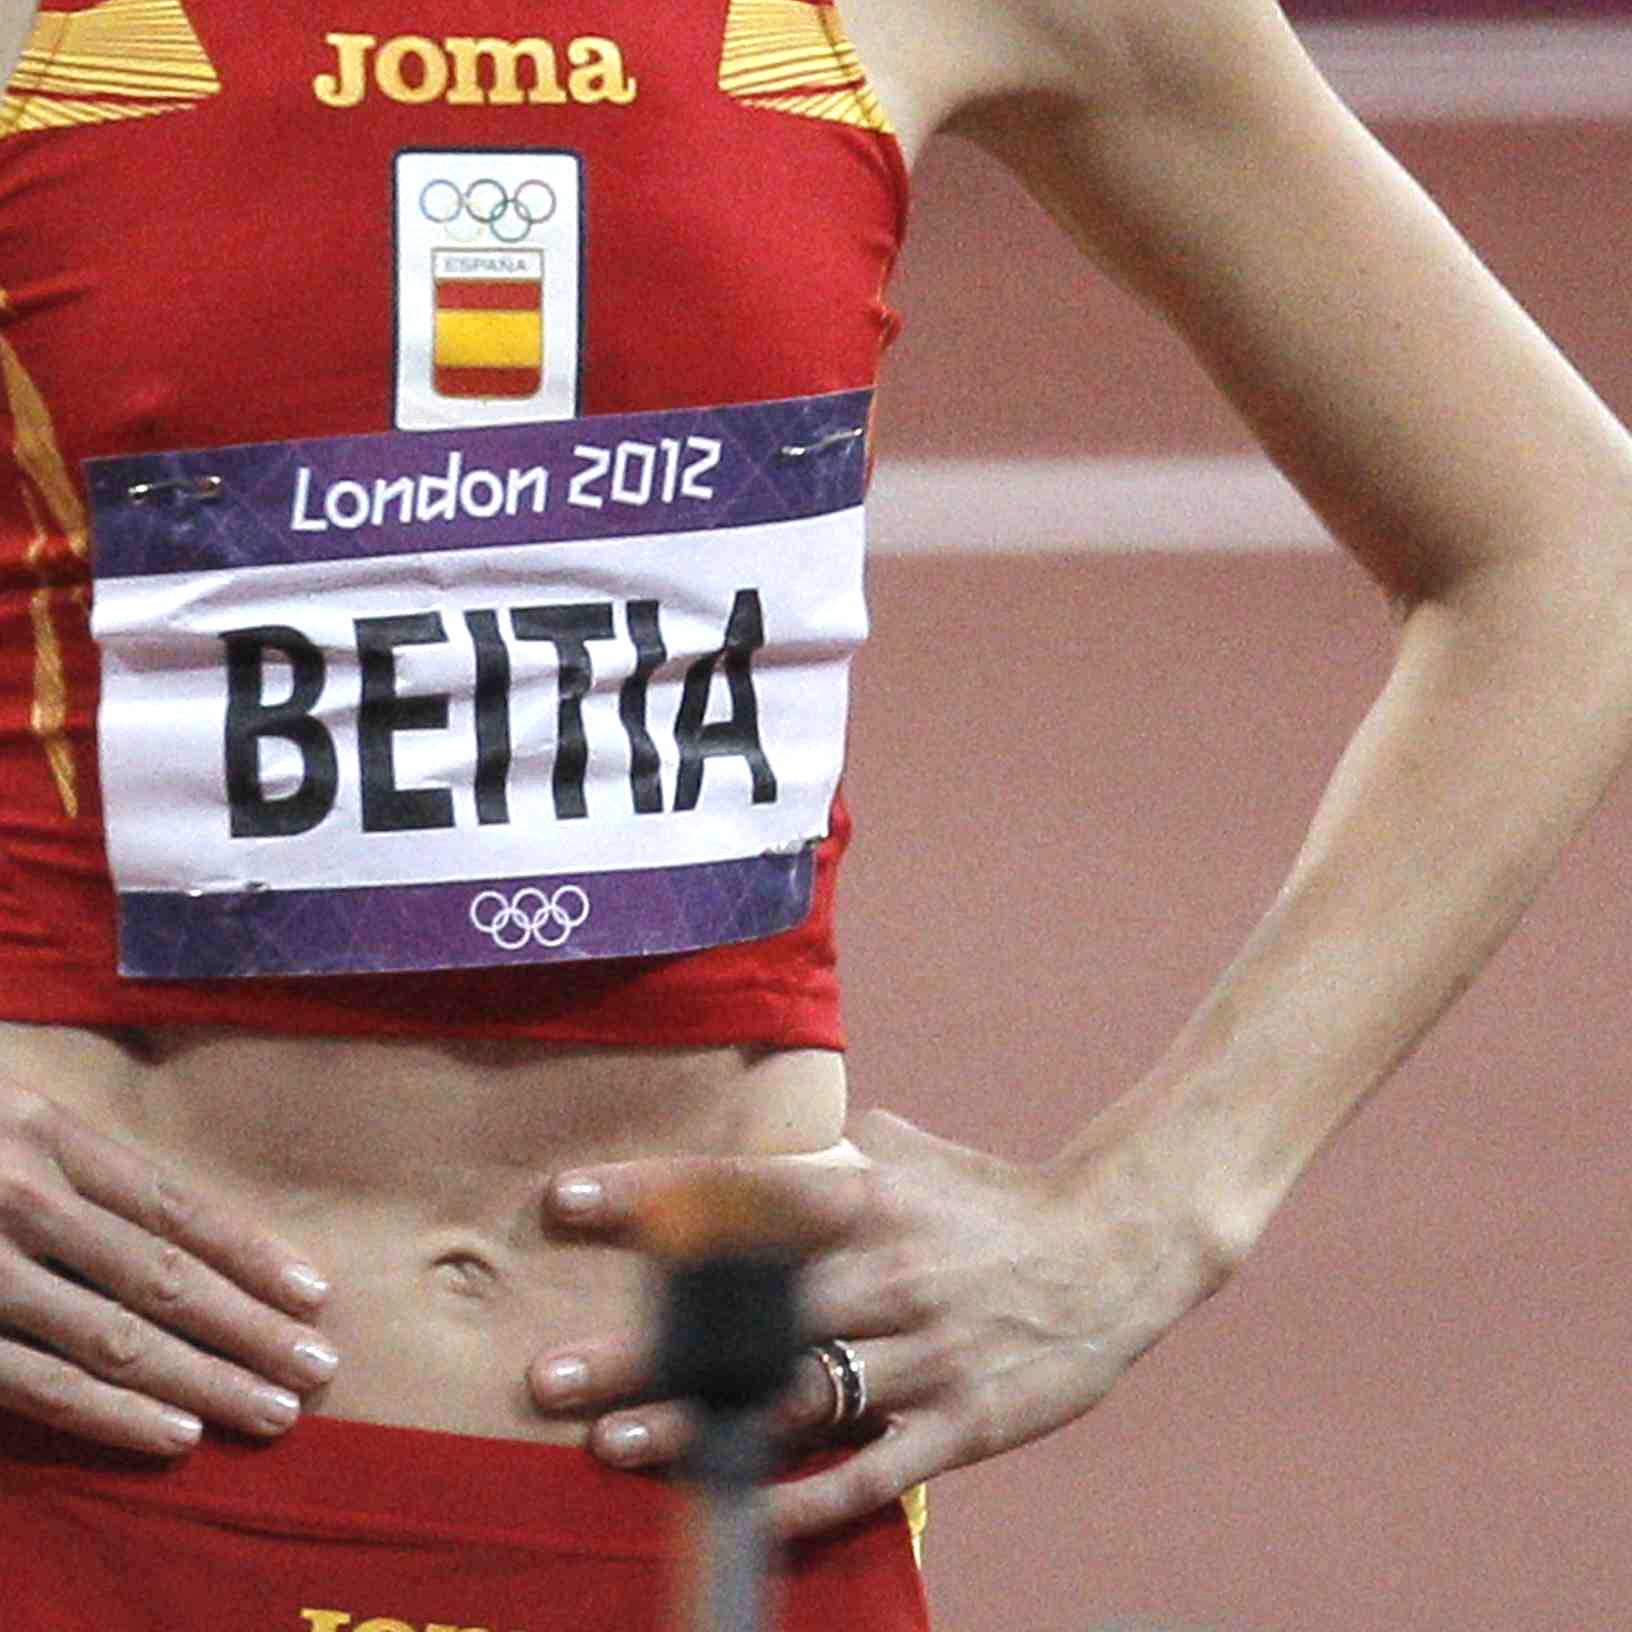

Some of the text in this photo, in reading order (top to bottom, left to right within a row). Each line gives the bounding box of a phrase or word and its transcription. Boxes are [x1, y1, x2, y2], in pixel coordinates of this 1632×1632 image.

[312, 31, 638, 108] Joma
[290, 435, 722, 532] London 2012
[217, 586, 779, 840] BEITIA
